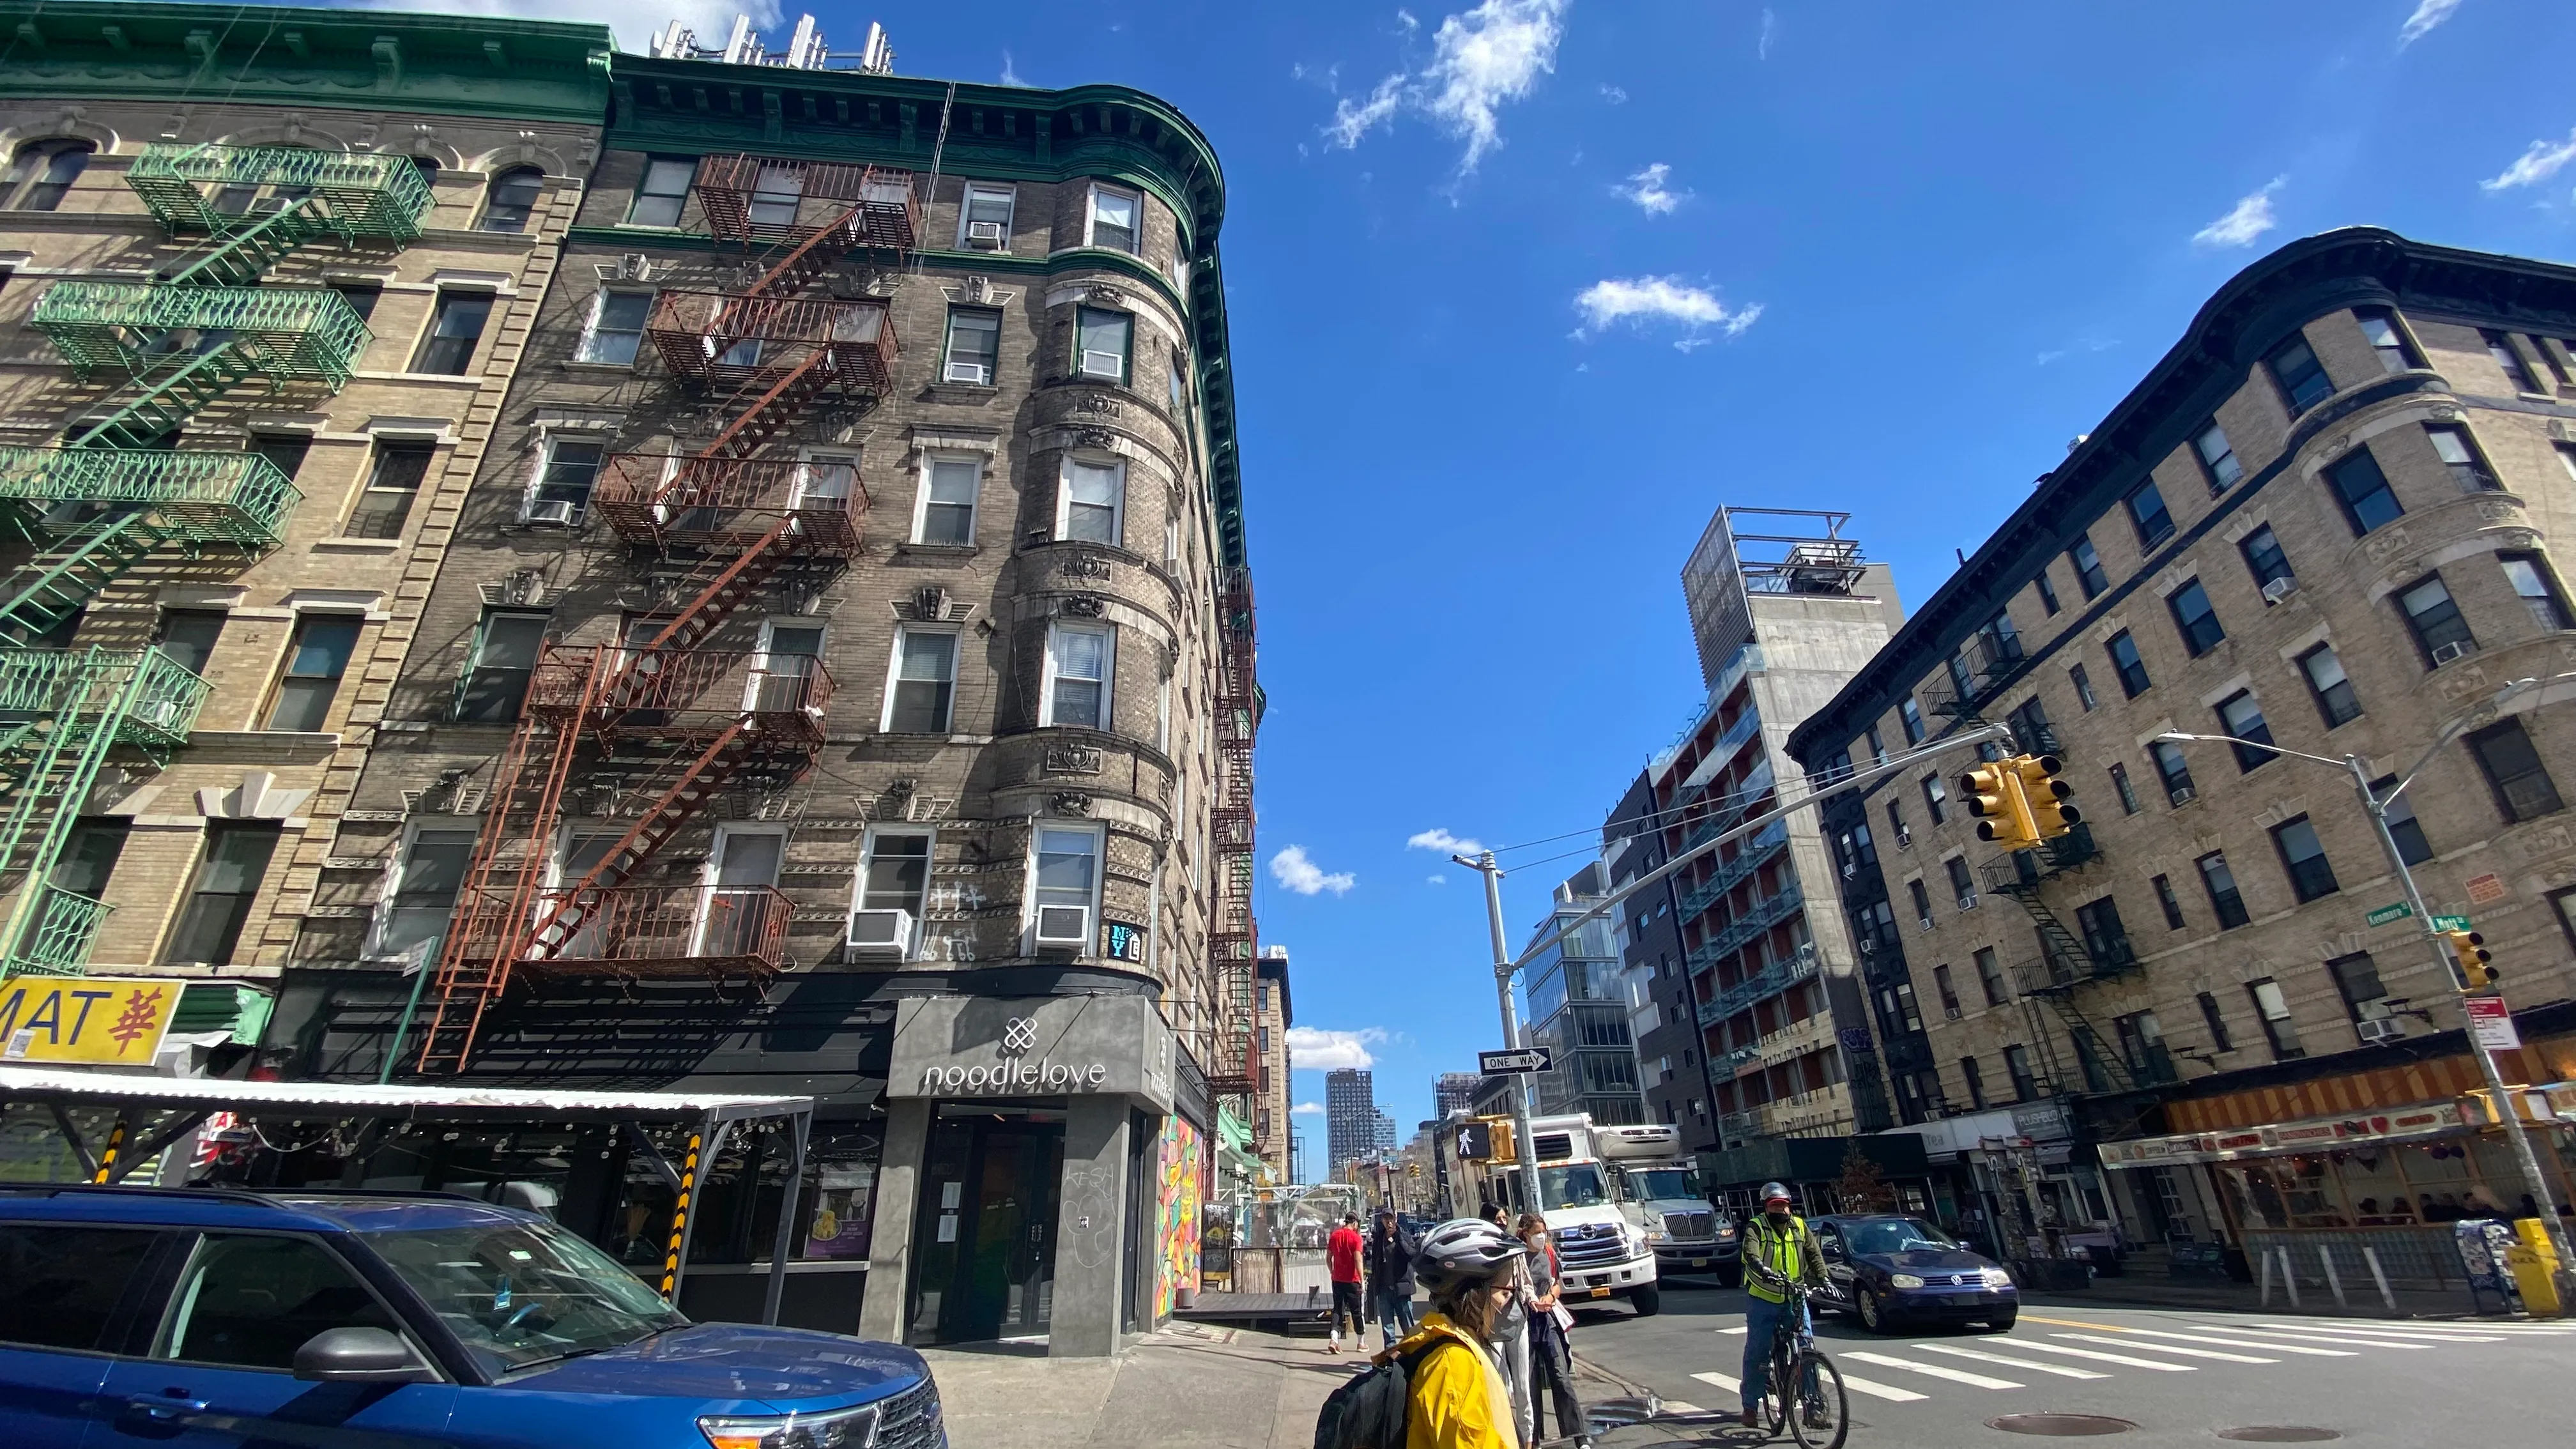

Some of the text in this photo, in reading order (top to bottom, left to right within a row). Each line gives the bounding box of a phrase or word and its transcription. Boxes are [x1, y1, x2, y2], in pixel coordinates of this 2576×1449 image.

[2368, 908, 2403, 925] Kenmare
[2436, 918, 2459, 930] Mott
[108, 986, 162, 1057] 華
[1490, 1055, 1540, 1068] ONE WAY
[925, 1056, 1107, 1086] noodlelove
